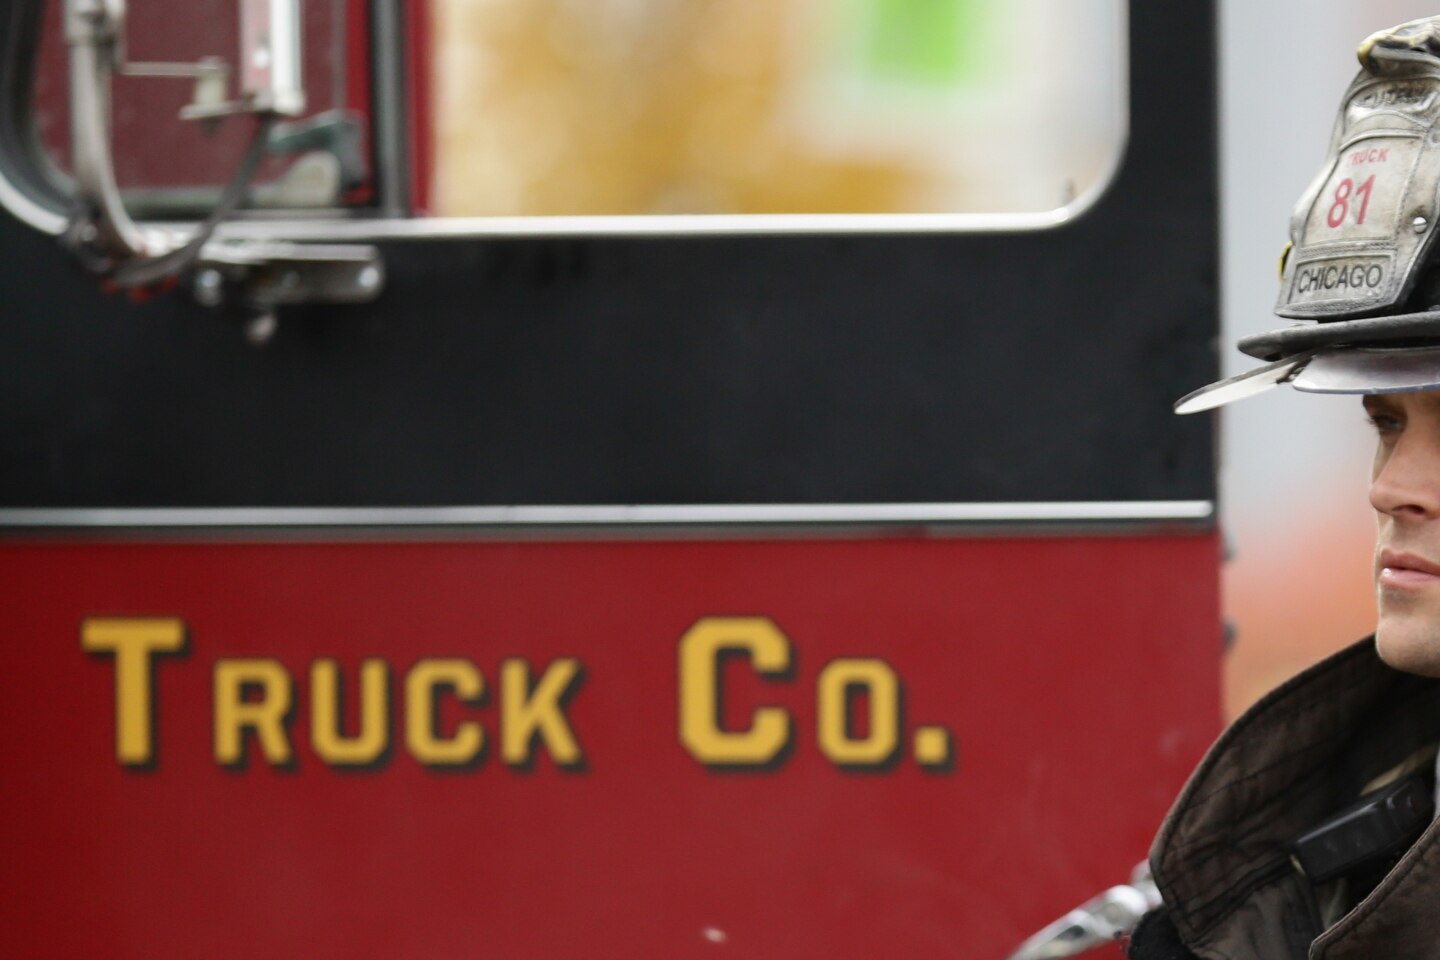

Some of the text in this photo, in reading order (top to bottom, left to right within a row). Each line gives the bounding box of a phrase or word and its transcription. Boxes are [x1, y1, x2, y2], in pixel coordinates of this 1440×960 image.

[1350, 148, 1389, 166] TRUCK
[1326, 174, 1377, 229] 81
[1297, 263, 1383, 294] CHICAGO
[80, 616, 584, 768] TRUCK
